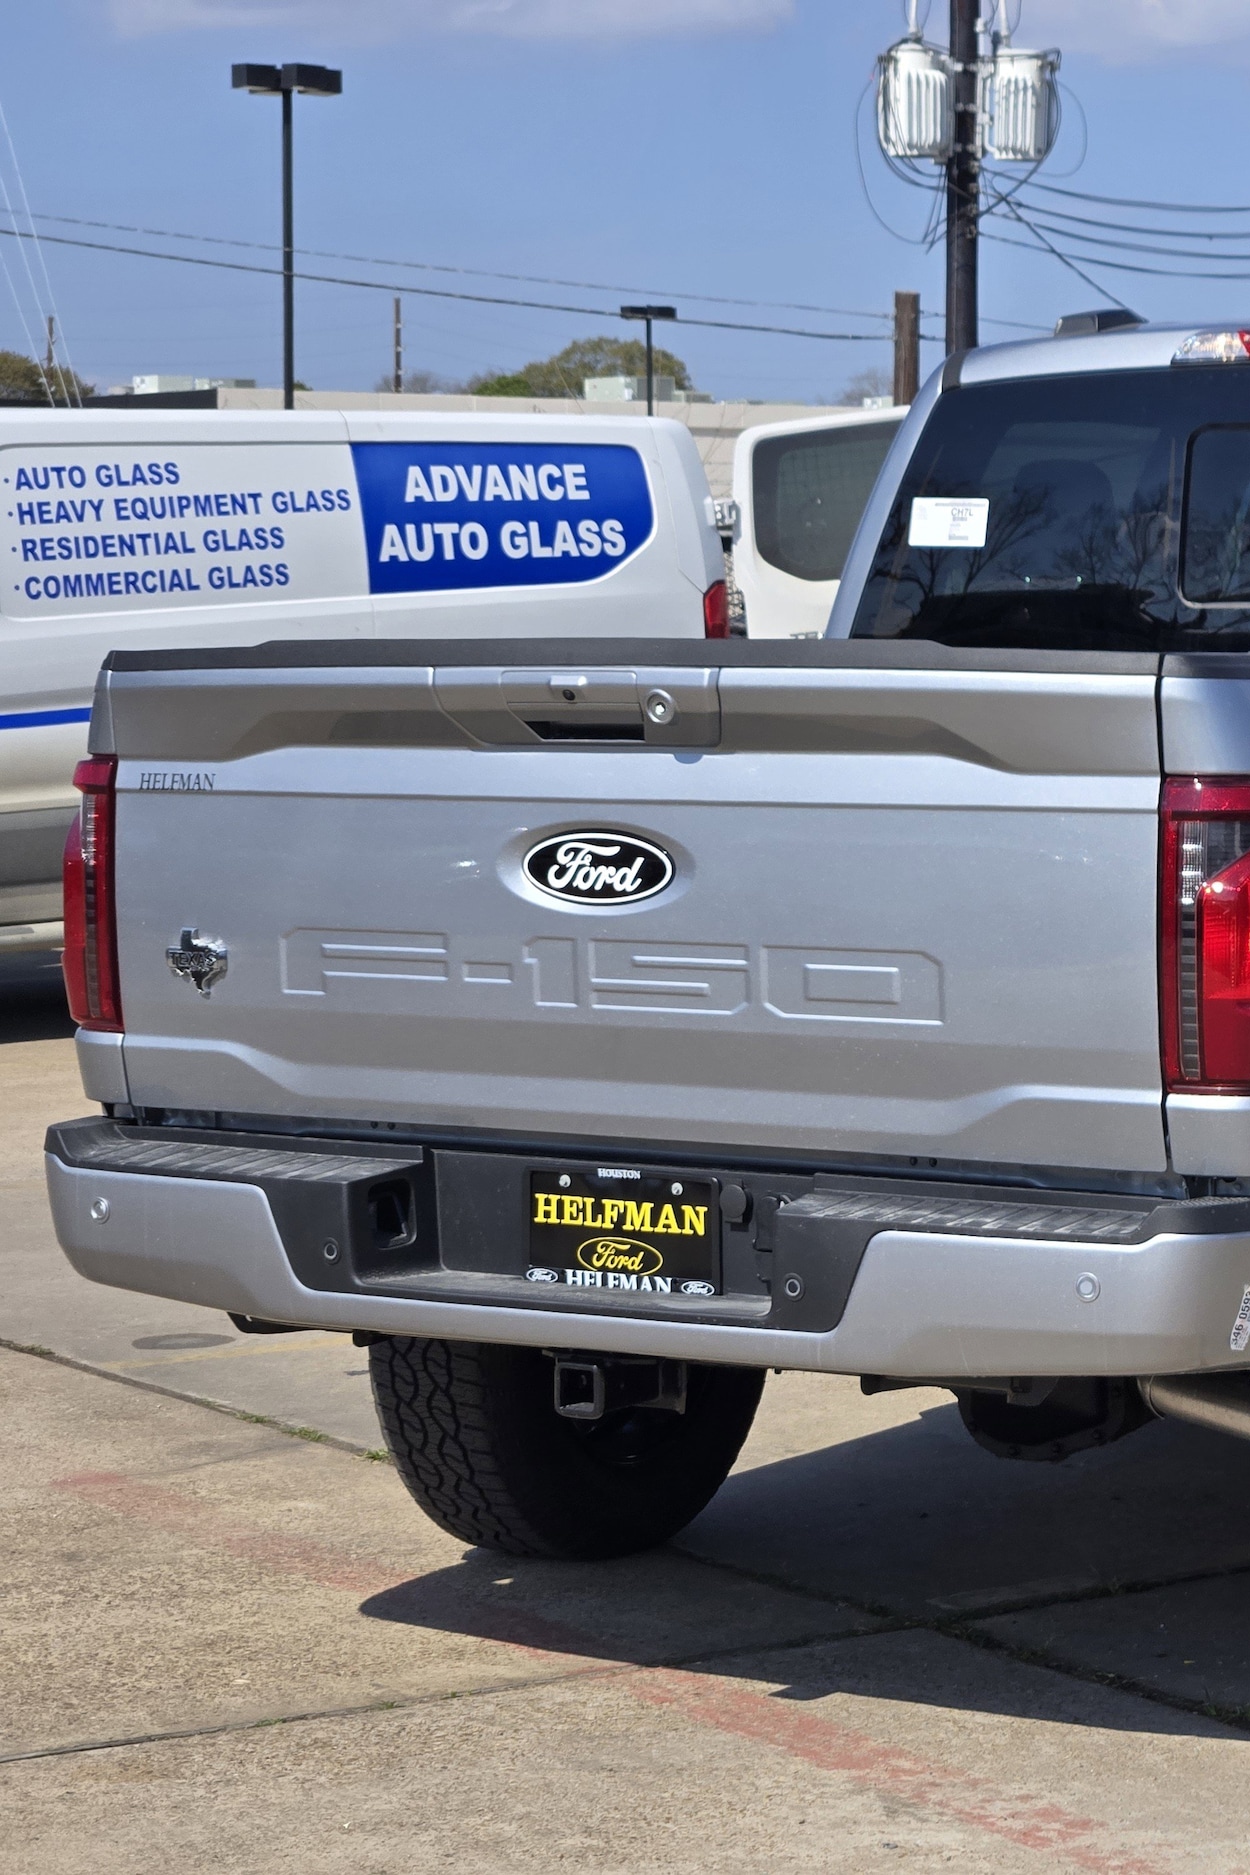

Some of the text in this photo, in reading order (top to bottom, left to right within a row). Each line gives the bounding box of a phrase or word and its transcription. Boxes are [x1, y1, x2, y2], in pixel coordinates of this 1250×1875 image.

[15, 462, 180, 490] AUTO GLASS
[404, 463, 590, 503] ADVANCE
[17, 489, 352, 525] HEAVY EQUIPMENT GLASS
[21, 527, 285, 562] RESIDENTIAL GLASS
[379, 518, 626, 563] AUTO GLASS
[24, 563, 290, 600] COMMERCIAL GLASS
[139, 772, 216, 790] HELFMAN
[547, 842, 645, 892] Ford
[168, 951, 218, 969] TEXAS
[280, 926, 944, 1026] F-150
[597, 1168, 641, 1180] HOUSTON
[533, 1193, 708, 1236] HELFMAN
[592, 1241, 645, 1271] Ford
[564, 1269, 673, 1294] HELFMAN
